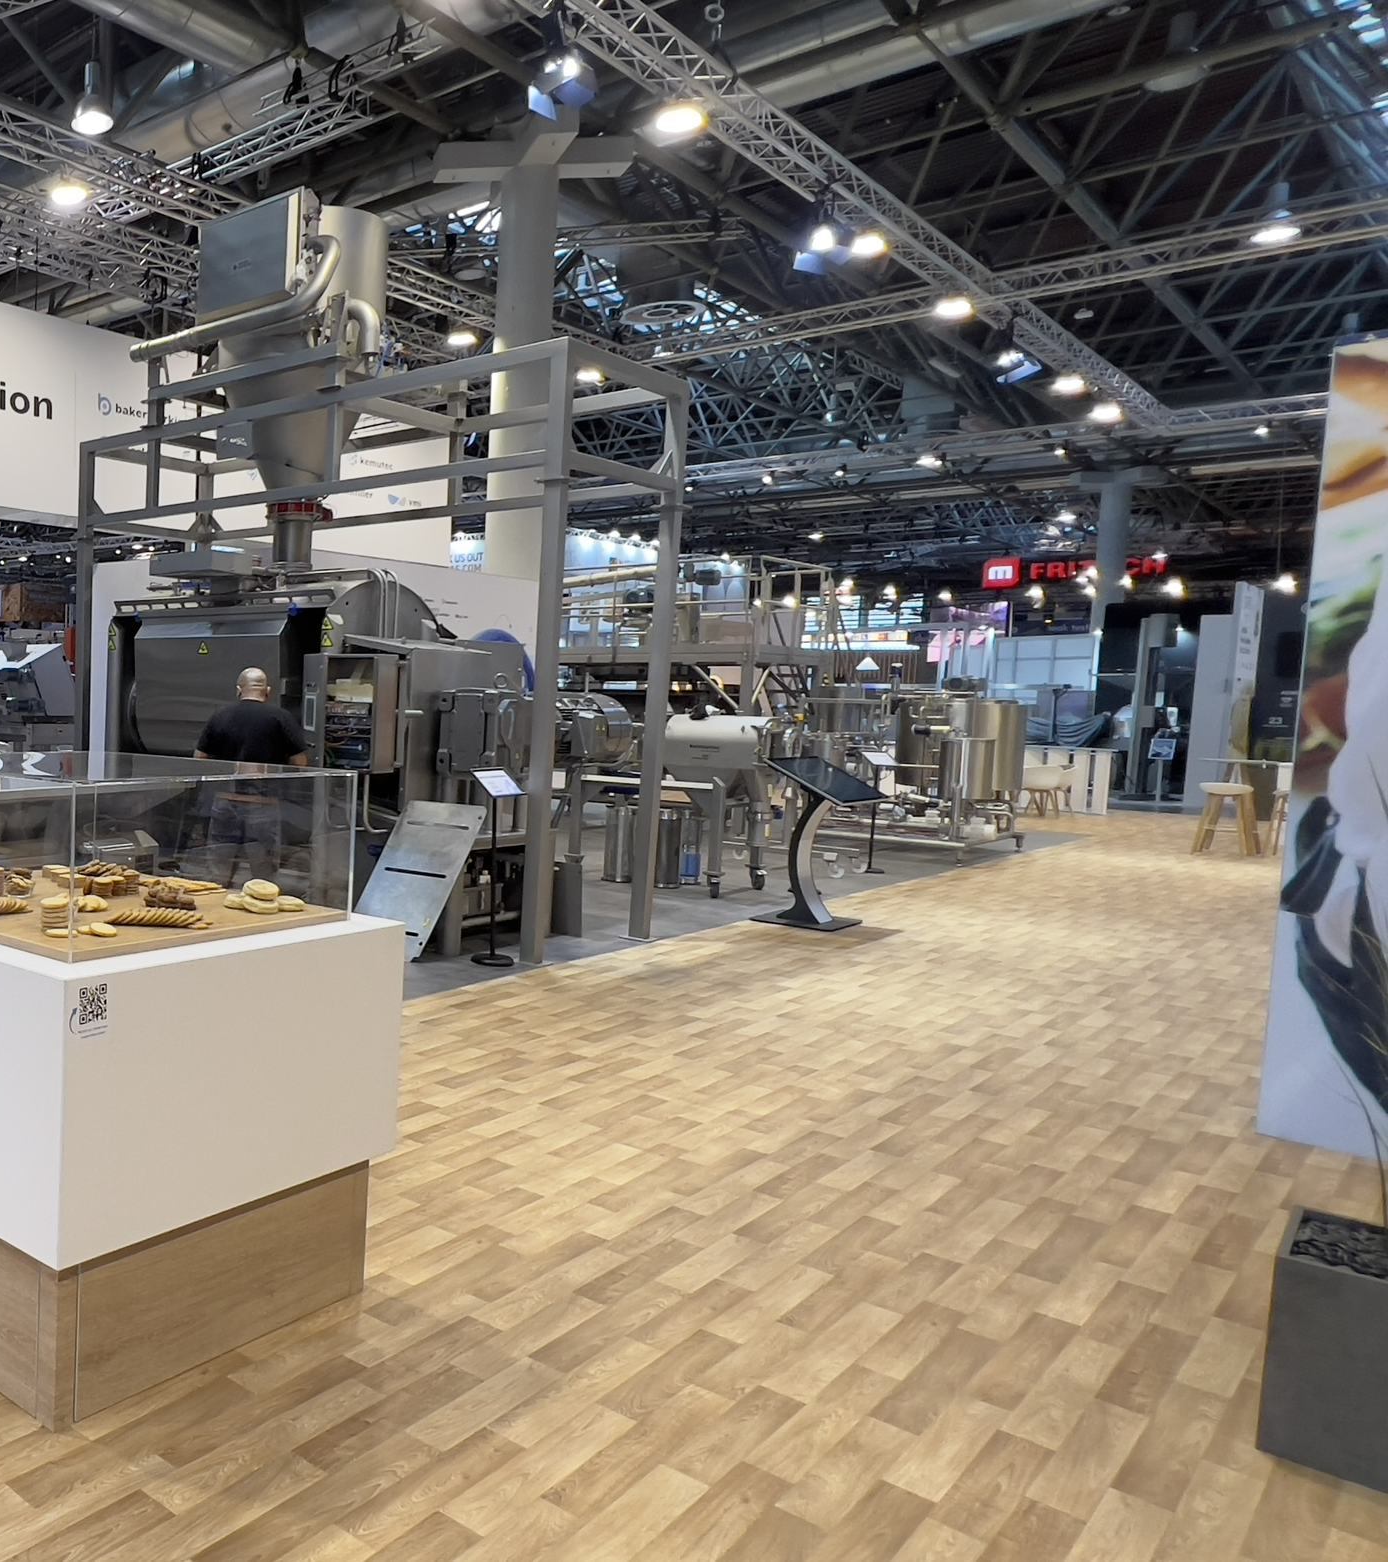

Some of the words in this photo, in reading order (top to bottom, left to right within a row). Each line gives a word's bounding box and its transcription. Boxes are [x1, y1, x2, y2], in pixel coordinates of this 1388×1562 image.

[115, 403, 148, 419] baker
[360, 456, 393, 470] kemutec
[454, 553, 466, 563] US
[467, 552, 484, 562] OUT
[1030, 556, 1168, 580] FRITCH
